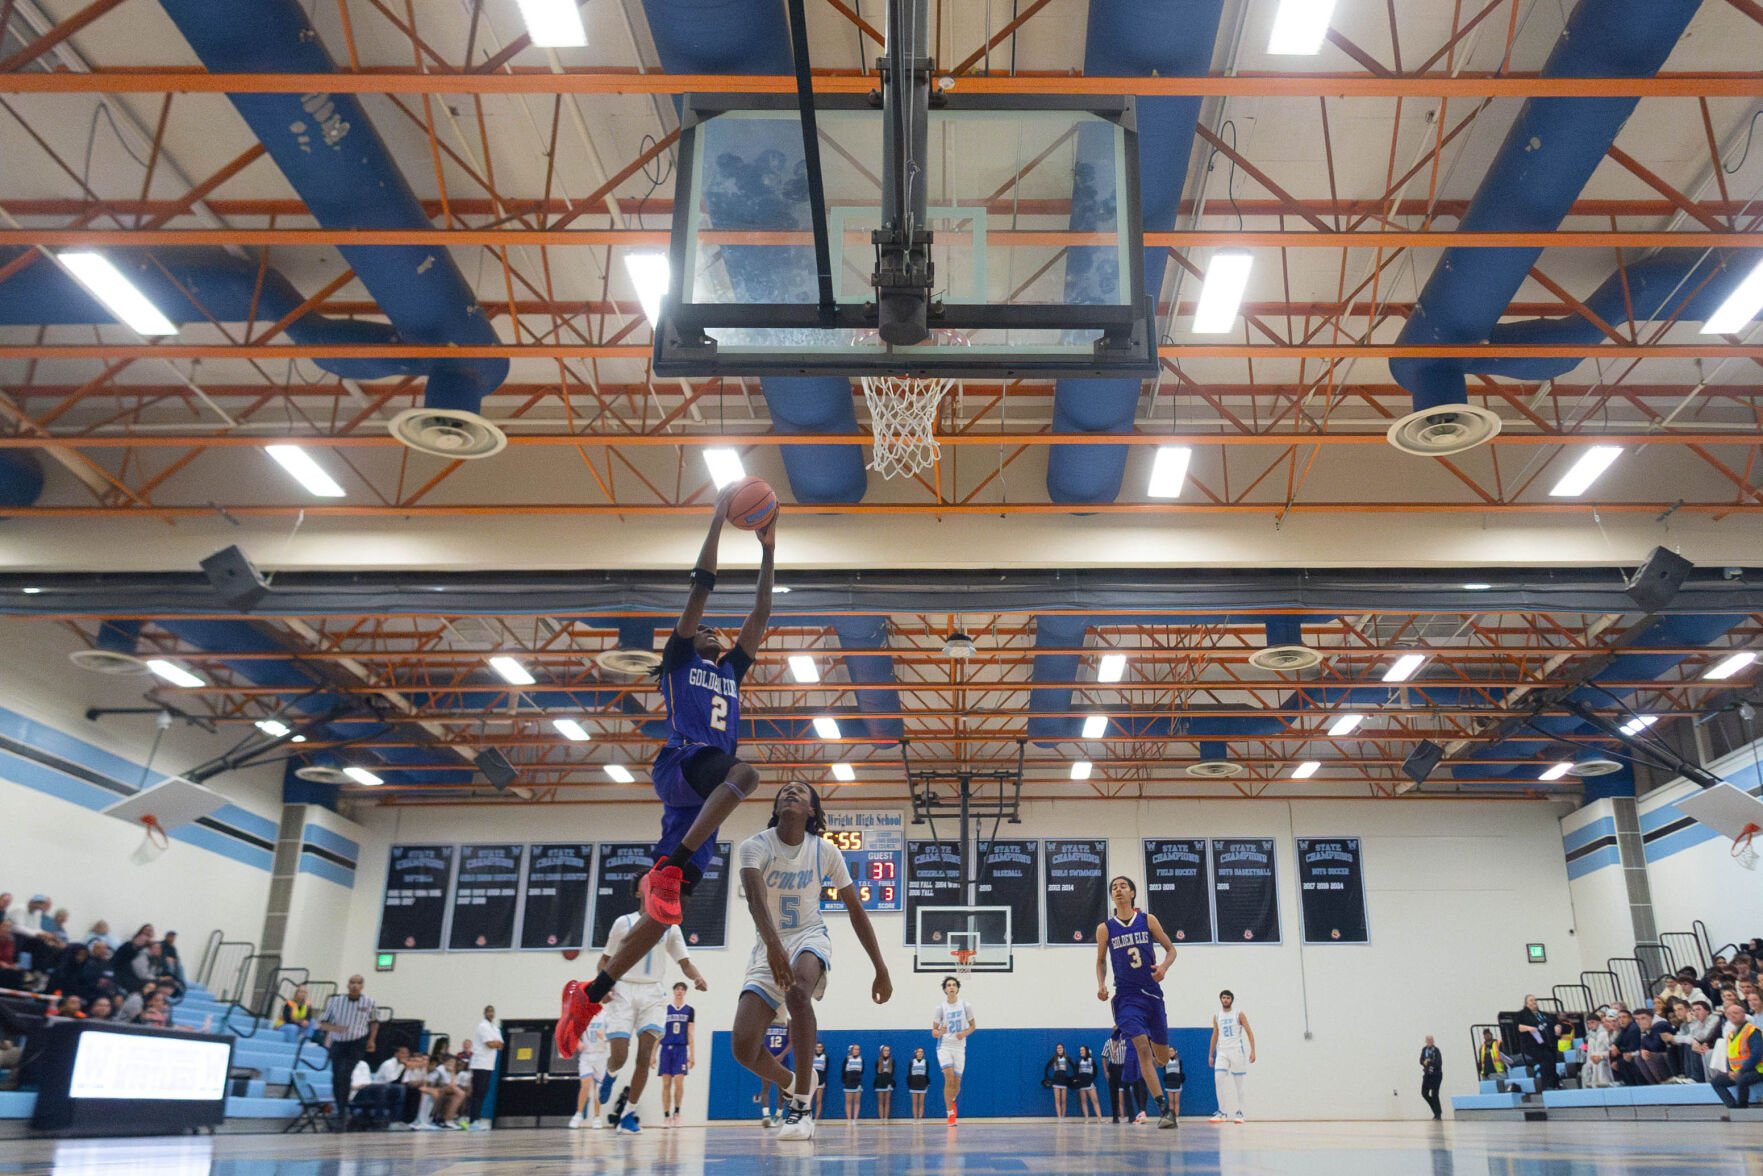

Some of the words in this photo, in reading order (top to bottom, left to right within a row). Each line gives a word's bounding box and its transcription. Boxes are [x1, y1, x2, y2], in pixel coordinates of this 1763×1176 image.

[710, 695, 728, 731] 2
[828, 814, 853, 827] Wright
[855, 814, 874, 827] High
[876, 814, 901, 826] School
[1162, 844, 1189, 852] STATE
[1230, 844, 1256, 852] STATE
[868, 852, 894, 860] GUEST
[872, 862, 895, 880] 37
[766, 869, 813, 890] CMW
[827, 888, 838, 900] 4
[860, 887, 871, 901] 5
[885, 887, 894, 901] 3
[779, 895, 800, 929] 5
[1111, 933, 1135, 949] GOLDEN
[1134, 931, 1149, 944] ELKS
[1127, 947, 1142, 969] 3
[1223, 1026, 1233, 1037] 21
[770, 1035, 782, 1048] 12
